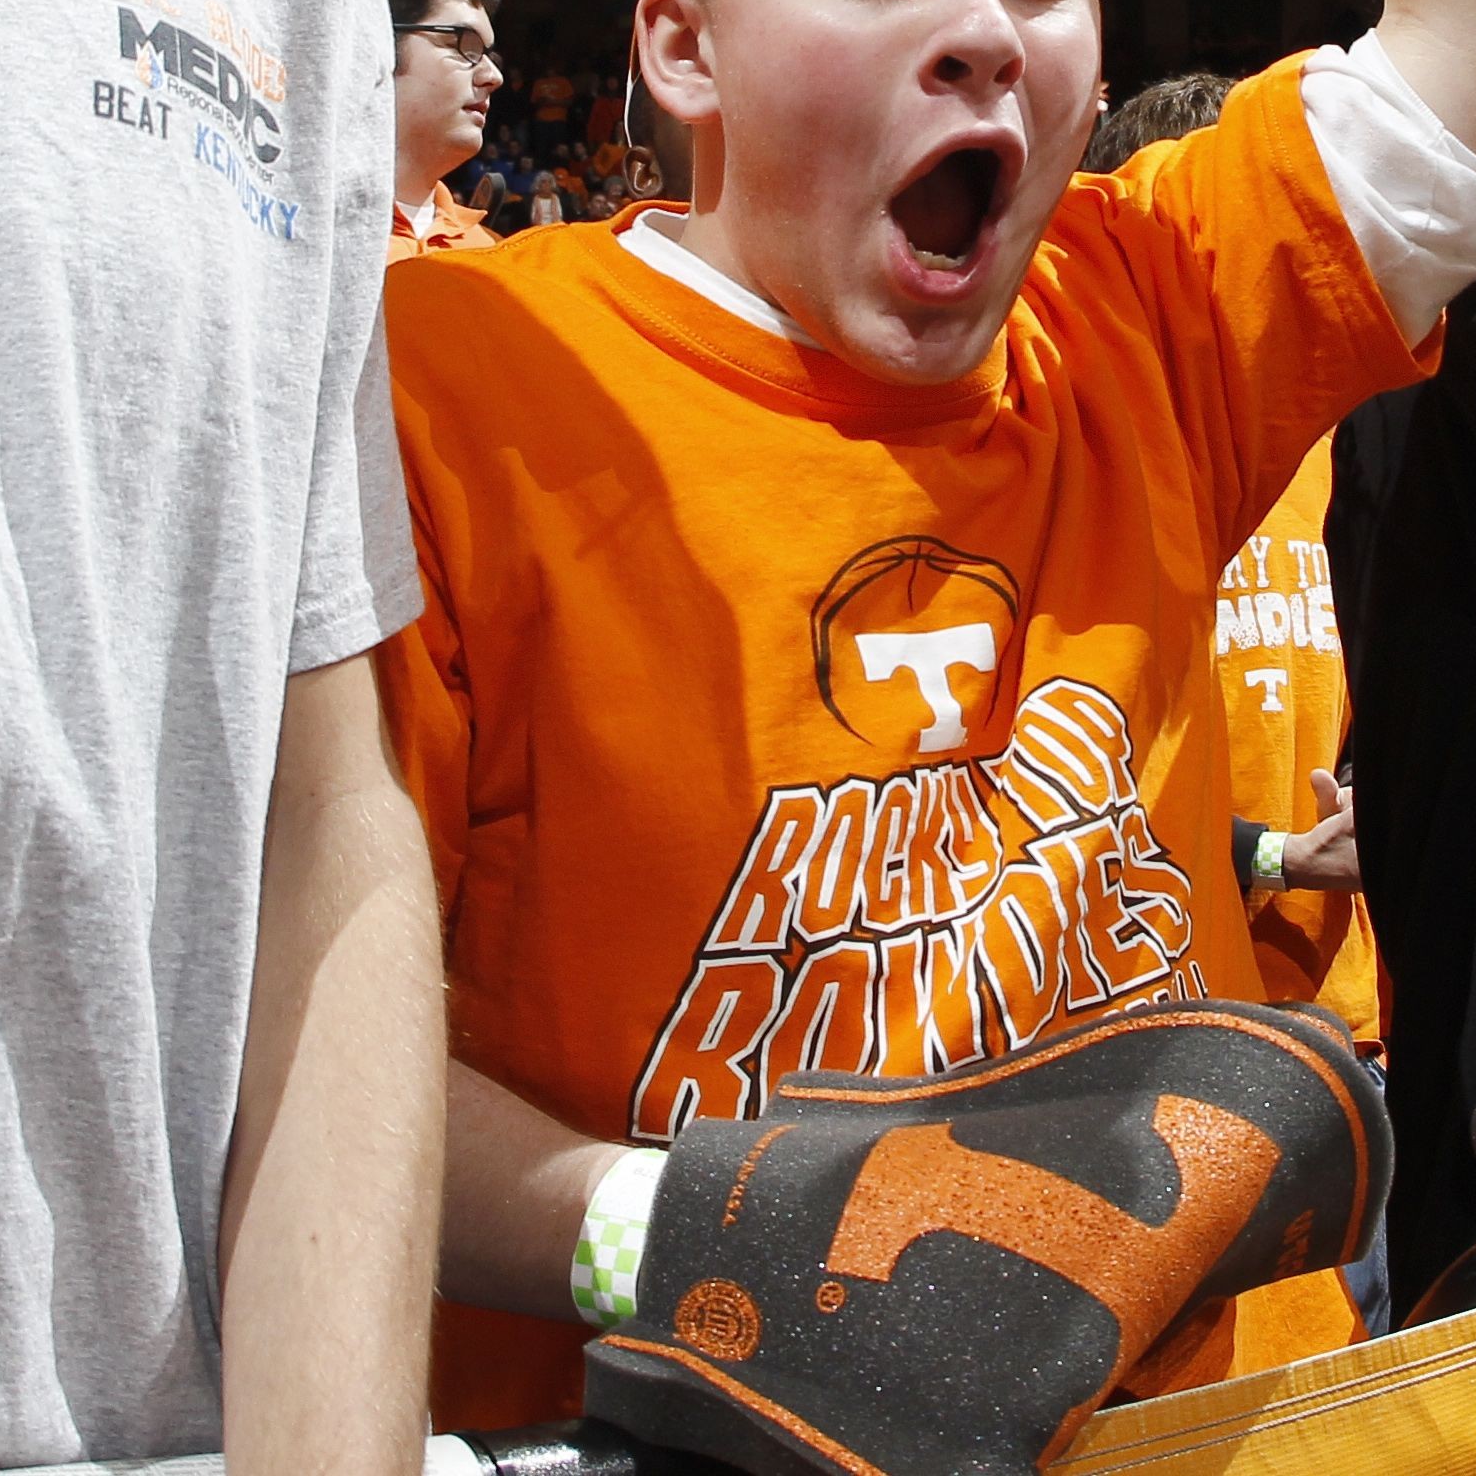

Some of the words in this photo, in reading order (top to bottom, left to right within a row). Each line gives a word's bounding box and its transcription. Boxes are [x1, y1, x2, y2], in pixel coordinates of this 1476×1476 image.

[93, 80, 172, 140] BEAT
[194, 121, 301, 241] KENTUCKY
[855, 622, 996, 753] T
[1244, 667, 1289, 712] T
[702, 764, 1004, 952] ROCKY
[631, 804, 1193, 1142] ROWDIES
